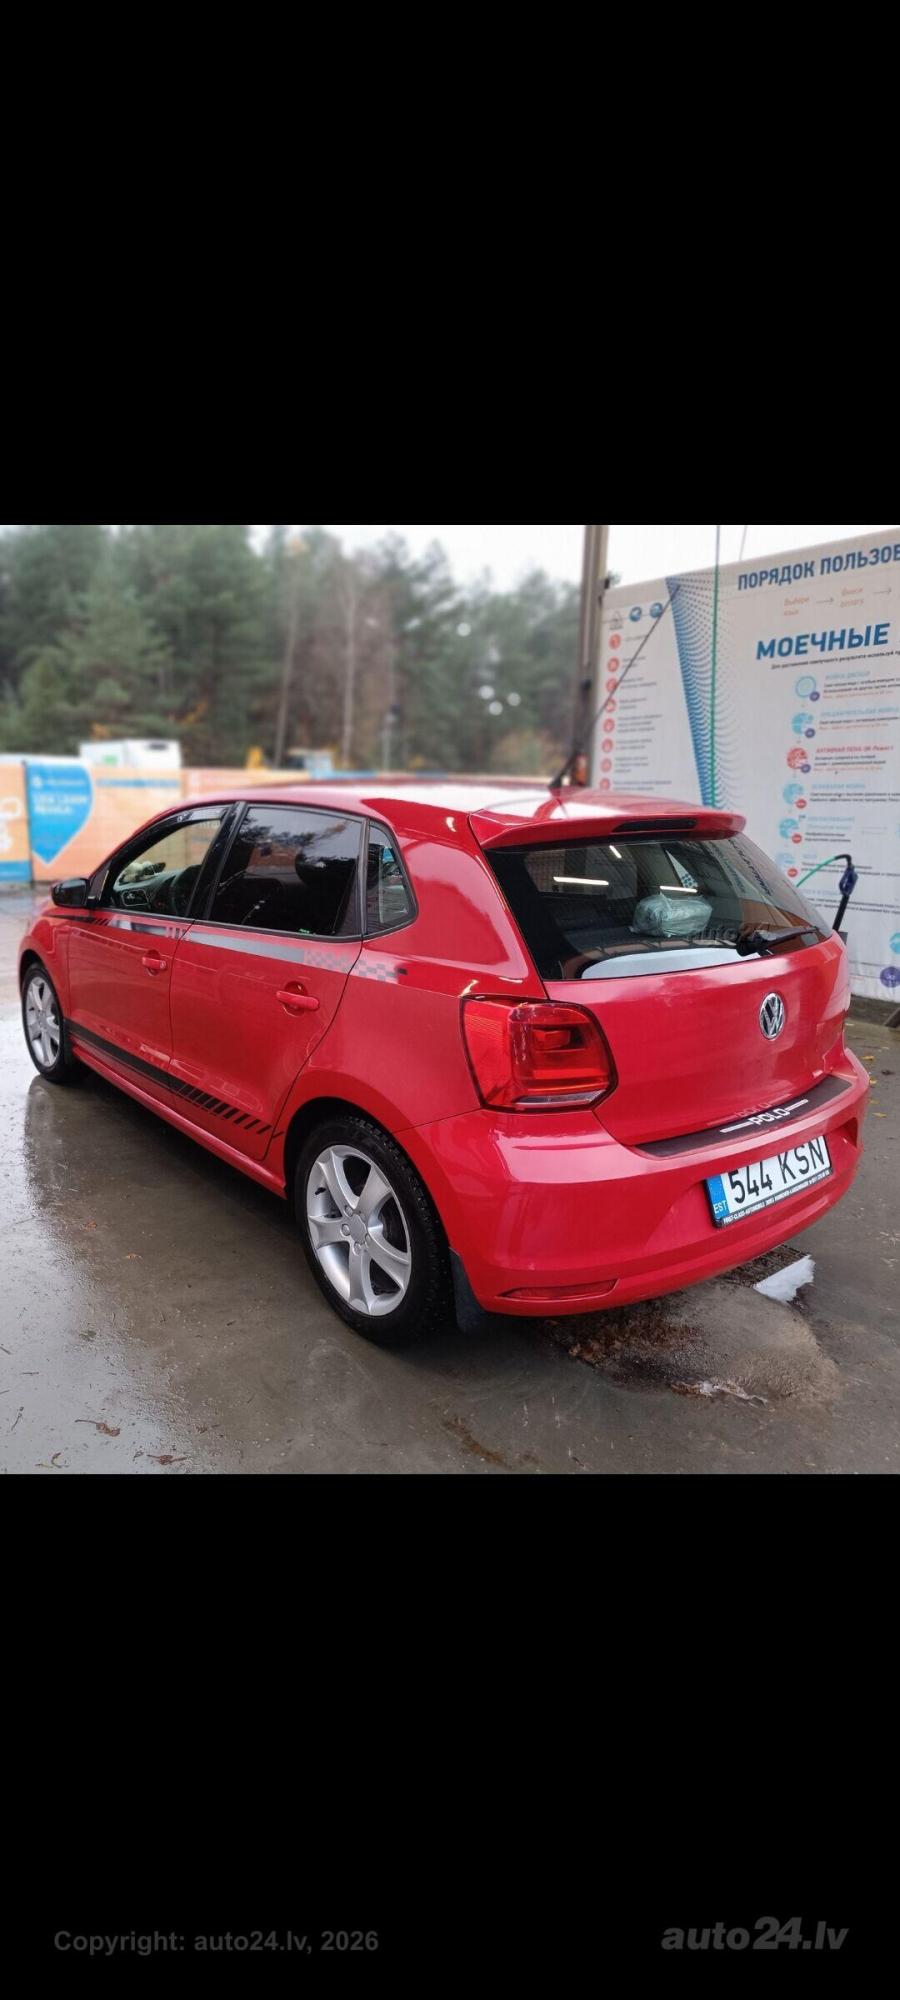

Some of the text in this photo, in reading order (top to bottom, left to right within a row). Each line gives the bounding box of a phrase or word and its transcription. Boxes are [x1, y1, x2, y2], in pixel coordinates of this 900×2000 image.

[738, 560, 815, 590] ПОРЯДОК
[756, 623, 890, 661] МОЕЧНЫЕ
[747, 1107, 791, 1126] POLO
[727, 1137, 825, 1205] 544 KSN
[713, 1200, 727, 1215] EST
